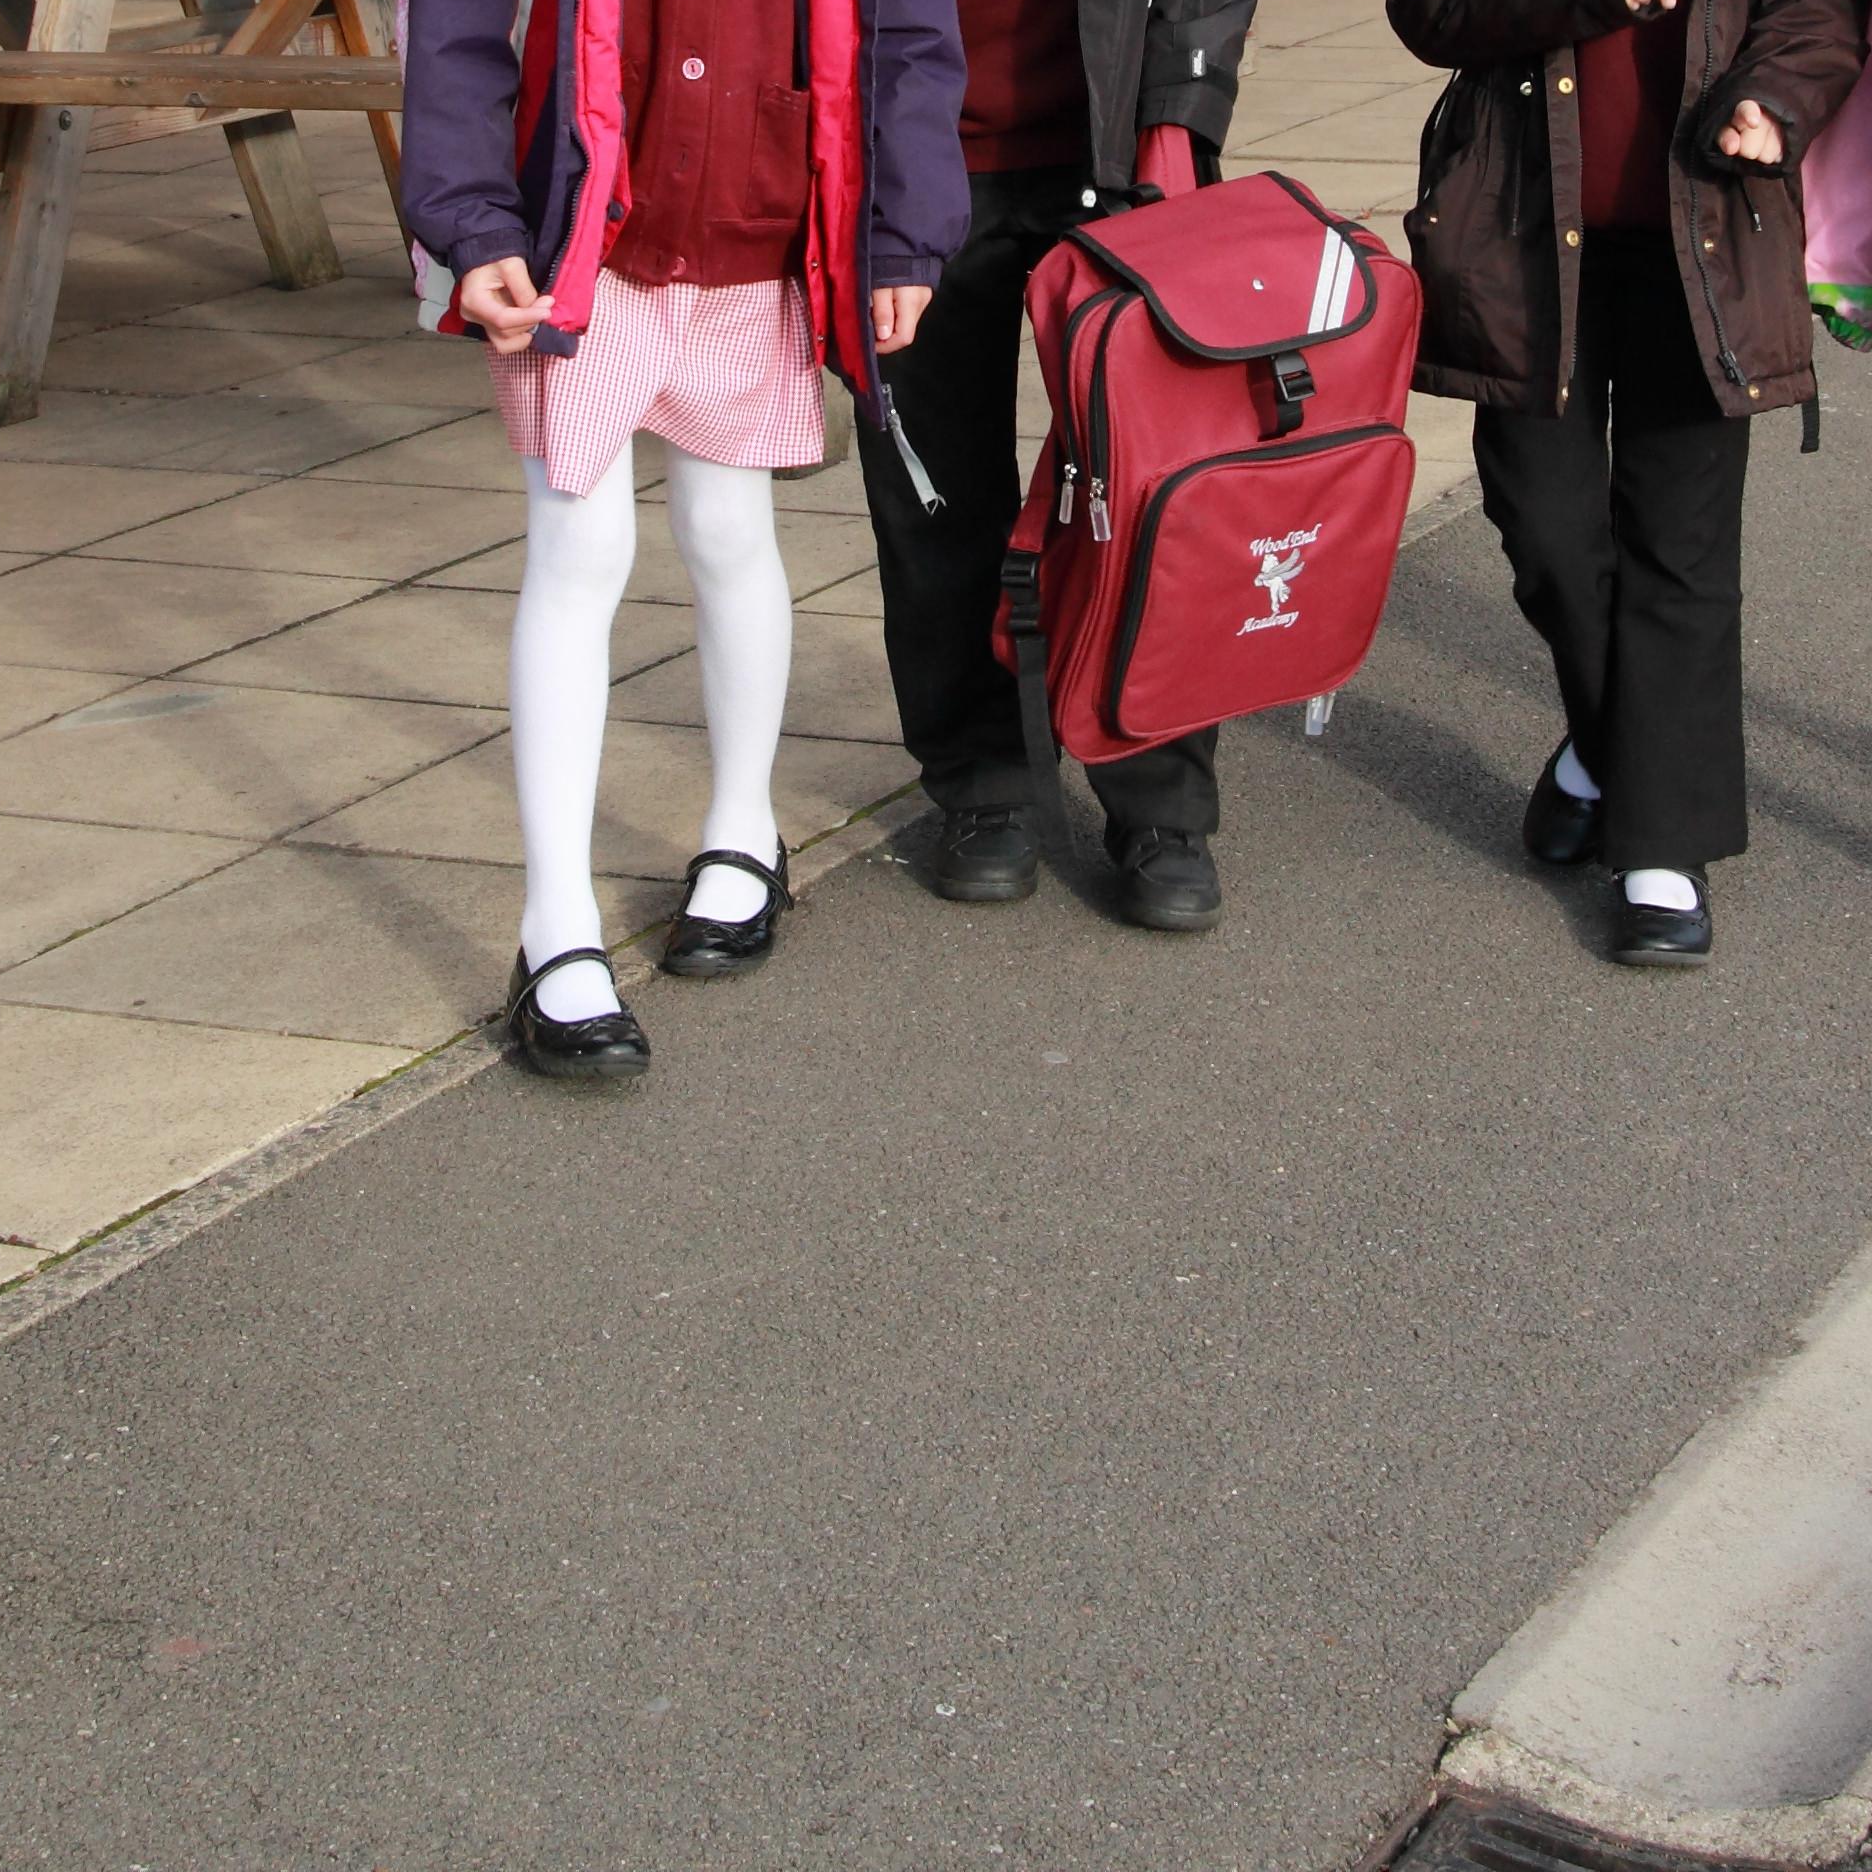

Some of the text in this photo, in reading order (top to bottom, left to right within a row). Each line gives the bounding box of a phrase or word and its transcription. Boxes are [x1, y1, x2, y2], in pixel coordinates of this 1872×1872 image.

[1250, 523, 1322, 556] Wood End
[1236, 611, 1299, 636] Academy
